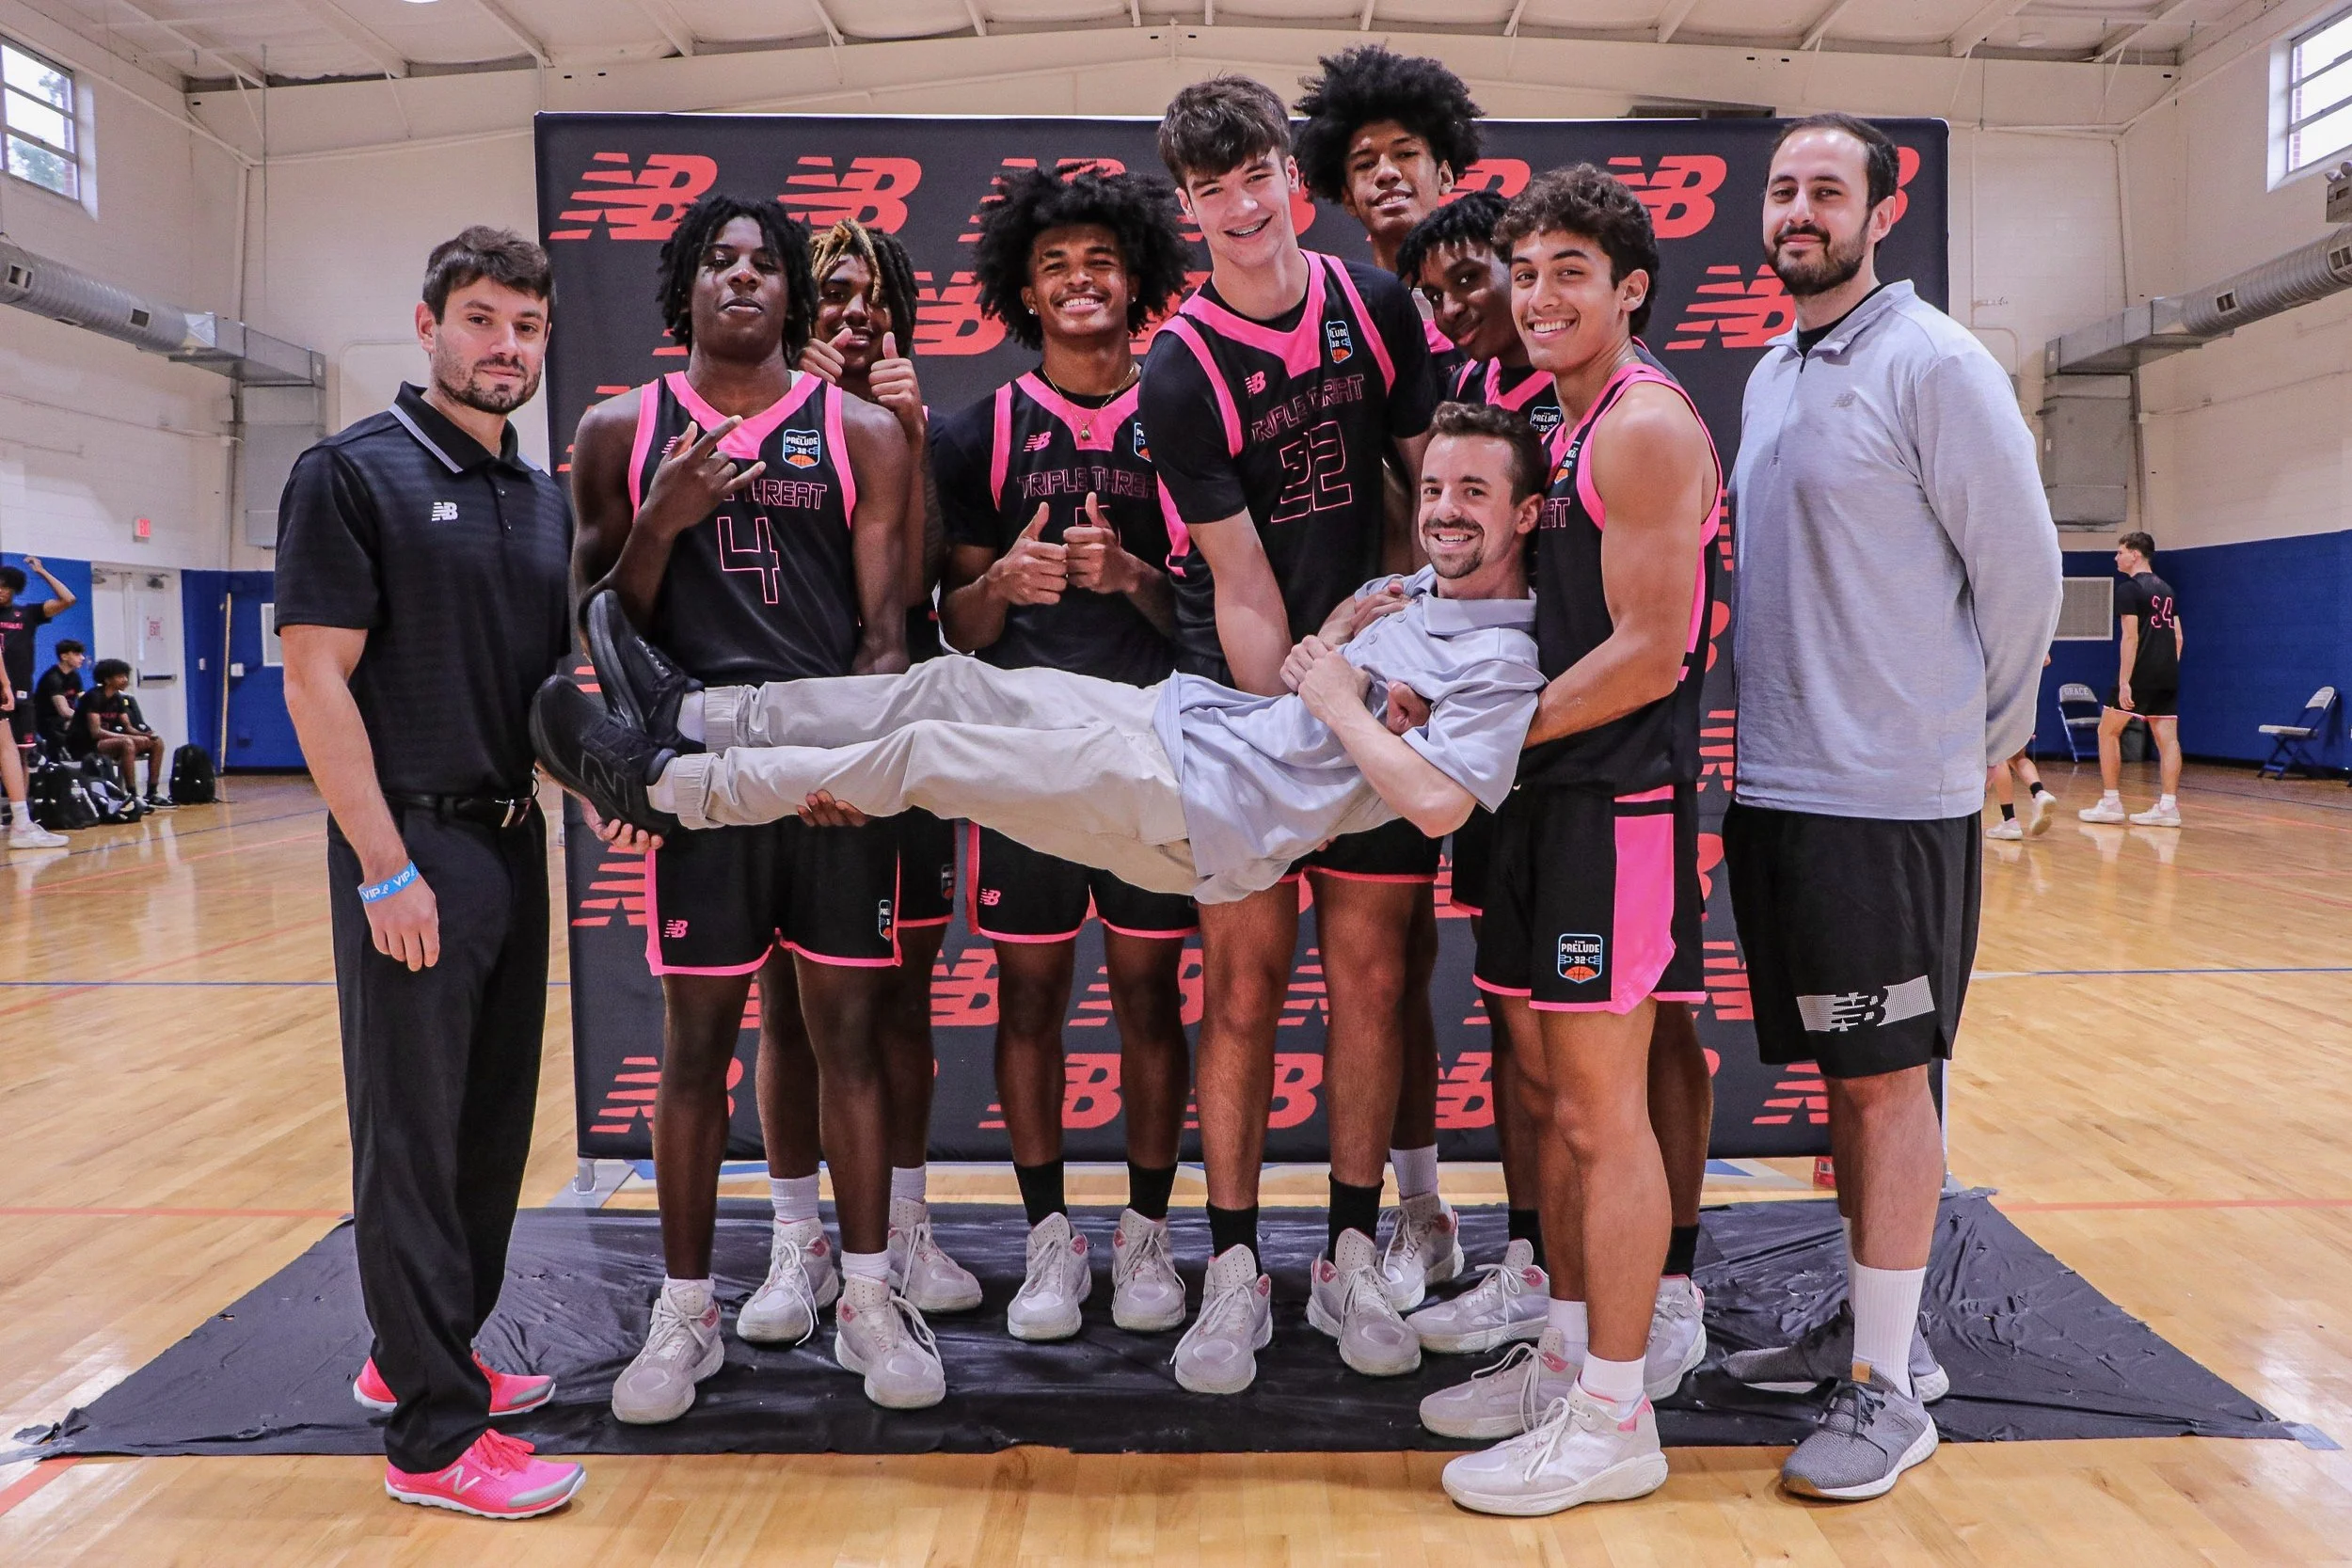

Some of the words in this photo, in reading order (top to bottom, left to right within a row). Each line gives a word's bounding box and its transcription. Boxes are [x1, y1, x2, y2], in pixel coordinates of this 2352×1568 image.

[786, 436, 818, 447] PRELUDE
[1017, 467, 1089, 499] TRIPLE
[431, 501, 458, 522] NB
[717, 515, 780, 604] 4
[361, 887, 380, 900] VIP
[392, 870, 411, 887] VIP
[663, 919, 689, 939] NB
[1561, 942, 1600, 953] PRELUDE
[1574, 956, 1586, 964] 32
